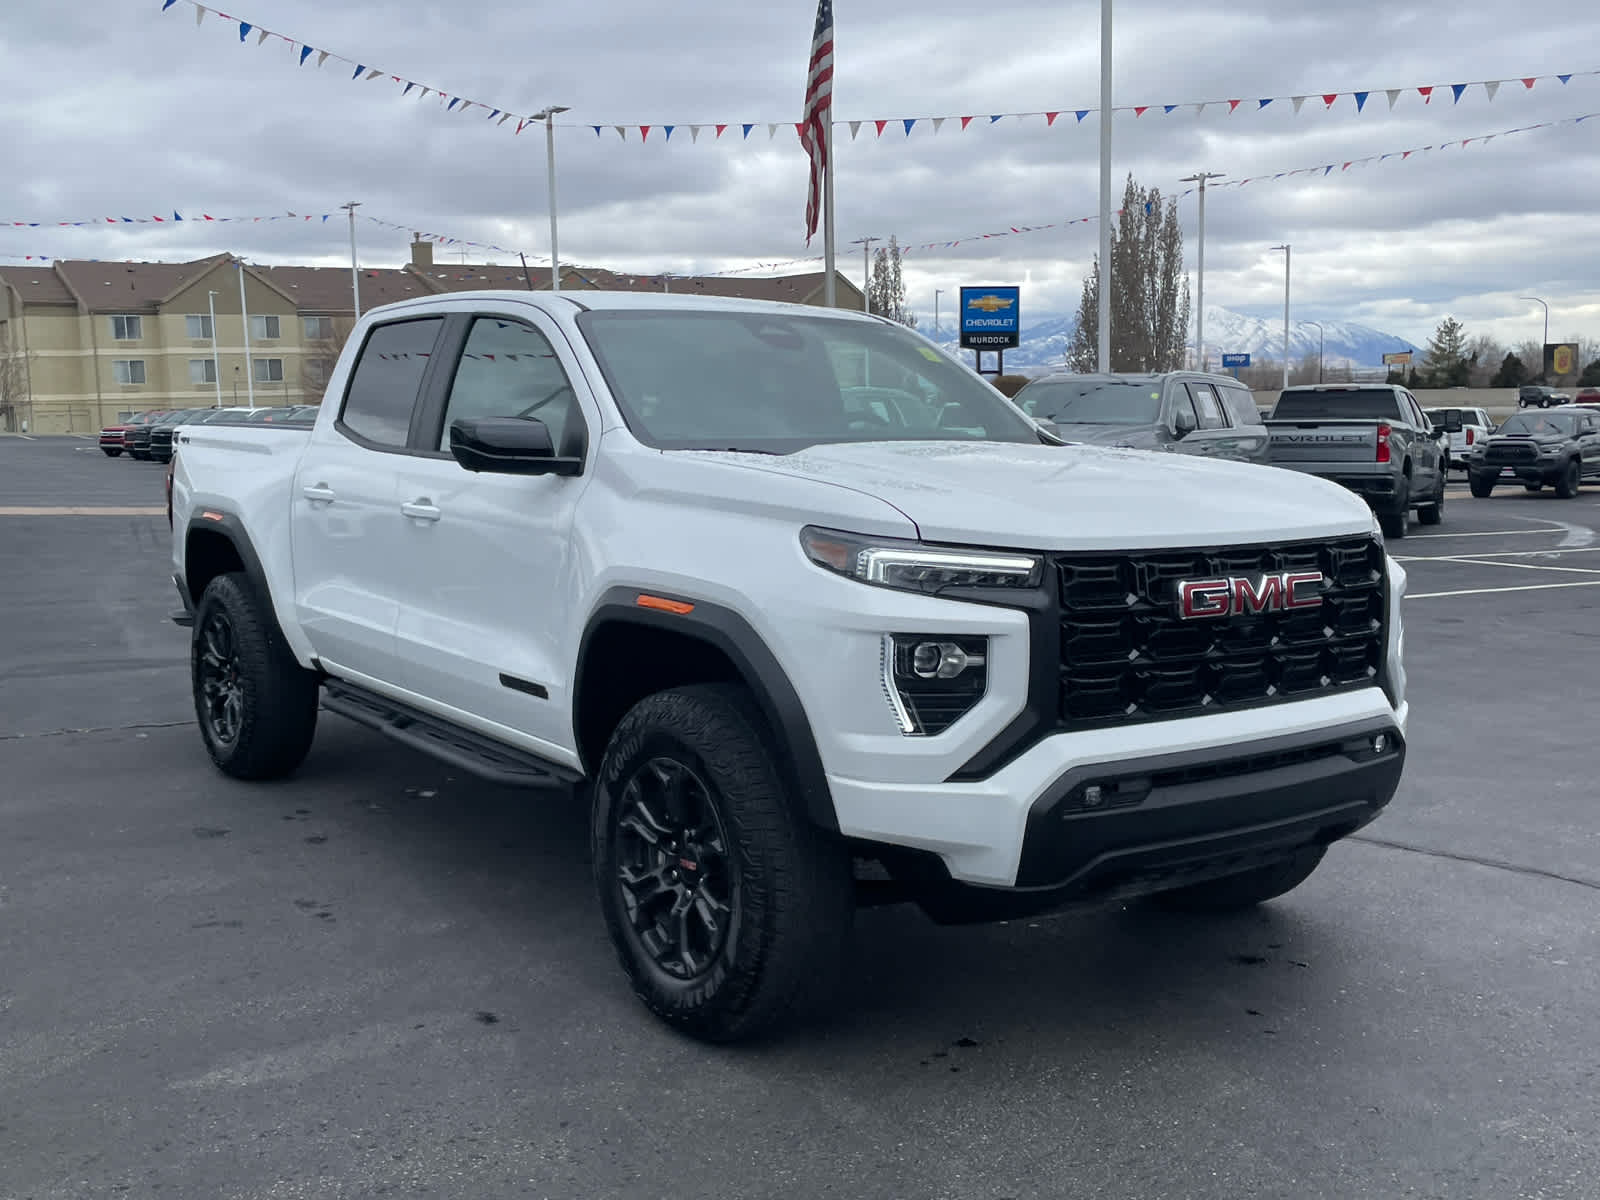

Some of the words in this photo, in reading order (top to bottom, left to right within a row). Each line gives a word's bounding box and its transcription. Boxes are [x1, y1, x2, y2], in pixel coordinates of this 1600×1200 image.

[966, 318, 1014, 327] CHEVROLET
[969, 336, 1010, 344] MURDOCK
[1178, 571, 1323, 620] GMC
